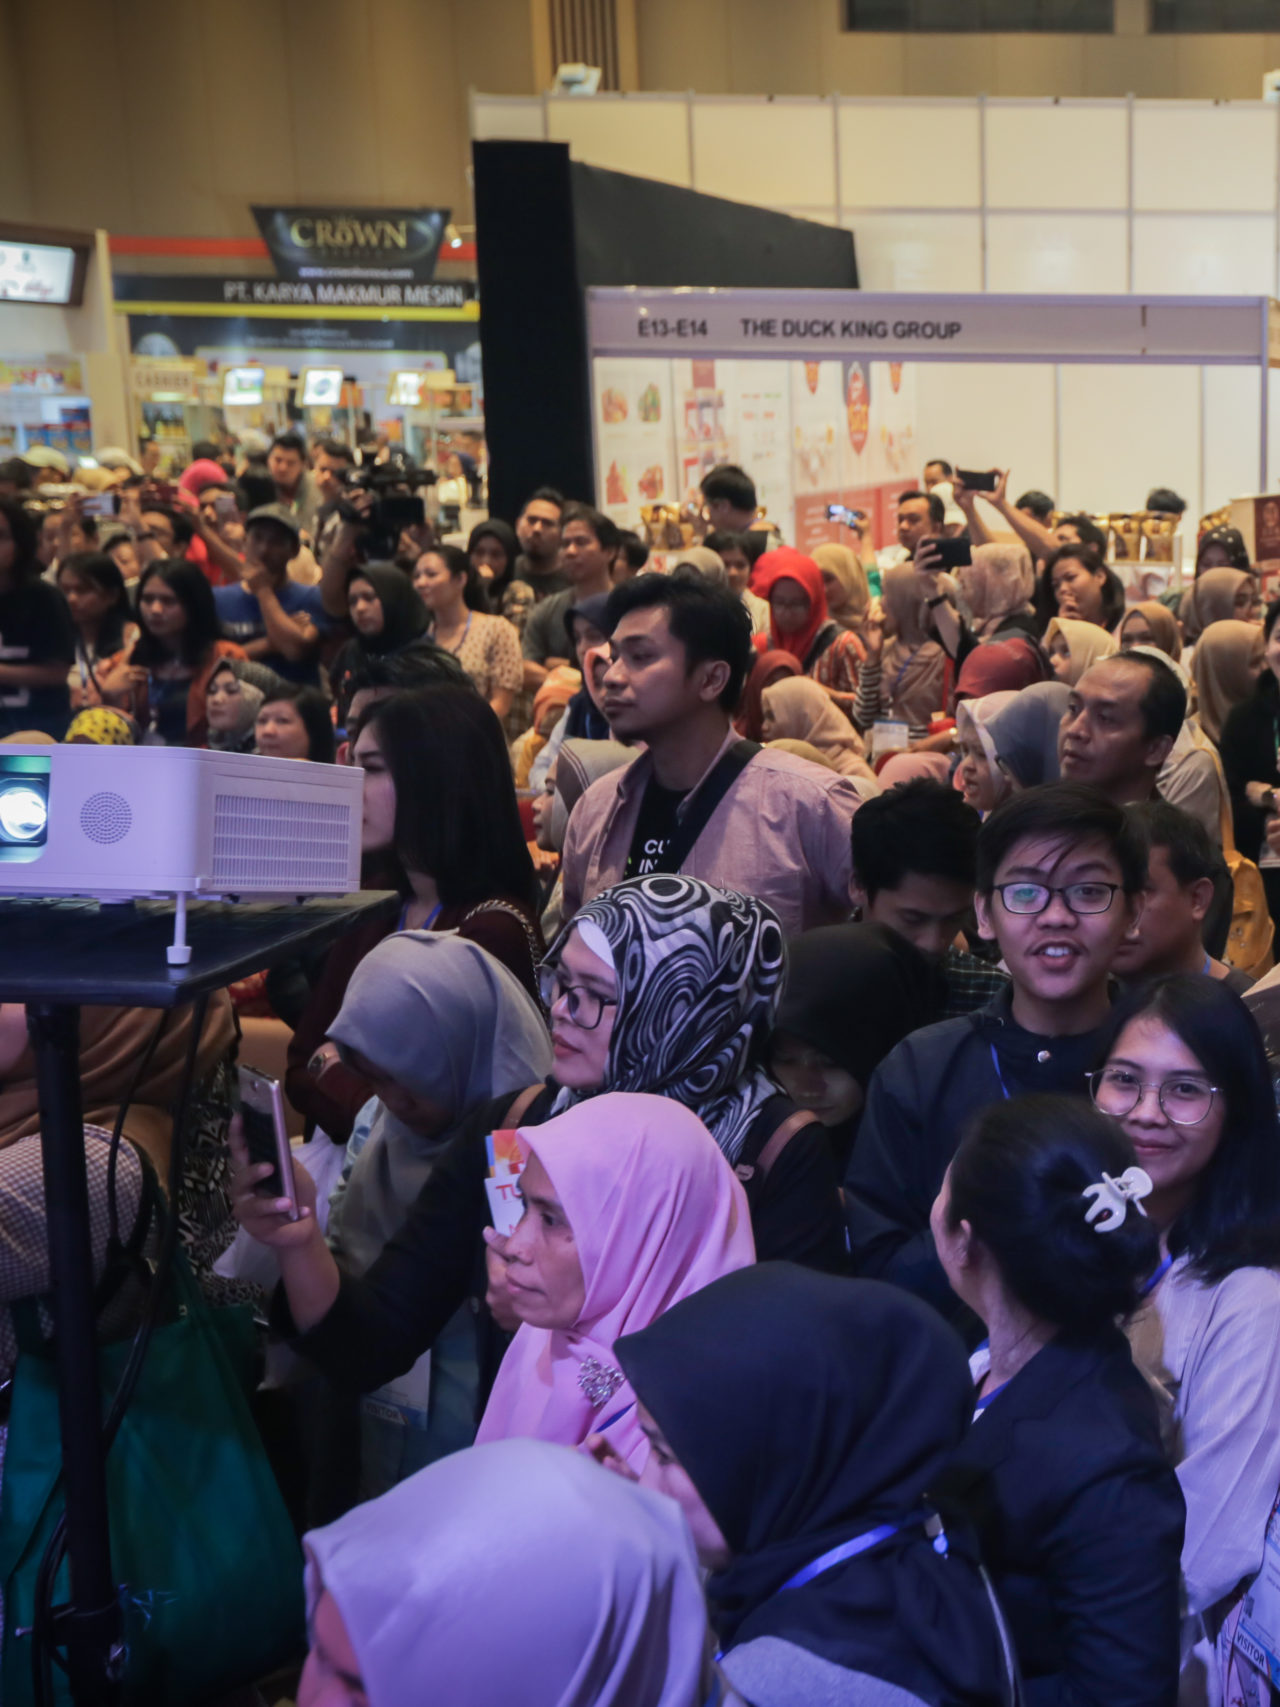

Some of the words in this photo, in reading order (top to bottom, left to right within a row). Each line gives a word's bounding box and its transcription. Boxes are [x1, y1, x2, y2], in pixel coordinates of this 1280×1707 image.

[290, 219, 407, 248] CROWN
[223, 281, 251, 300] PT.
[253, 282, 314, 303] KARYA
[316, 283, 401, 305] MAKMUR
[404, 285, 463, 305] MESIN
[637, 318, 708, 338] E13-E14
[740, 318, 777, 338] THE
[781, 318, 836, 338] DUCK
[841, 319, 888, 339] KING
[893, 320, 962, 340] GROUP
[1236, 1630, 1265, 1668] VISITOR
